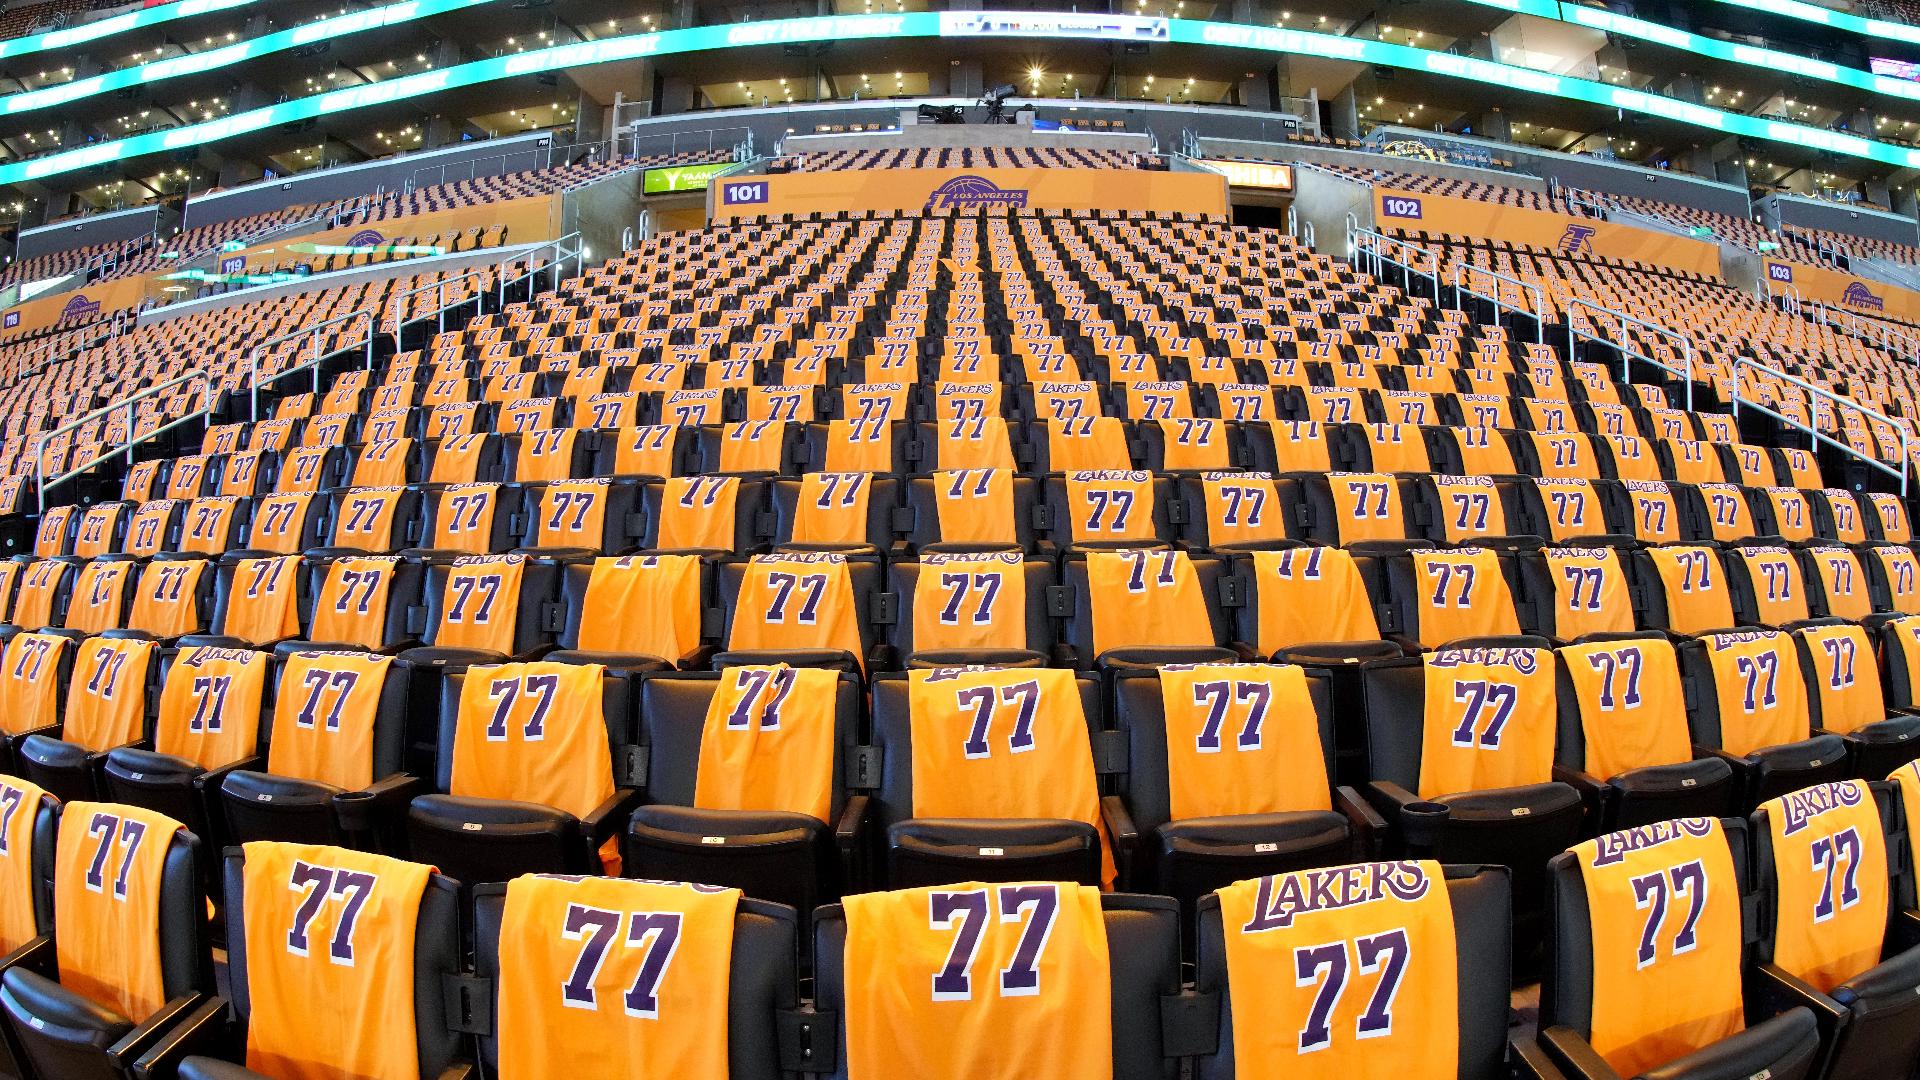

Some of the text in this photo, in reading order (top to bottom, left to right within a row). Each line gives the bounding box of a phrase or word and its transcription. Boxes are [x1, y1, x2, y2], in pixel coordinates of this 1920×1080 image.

[729, 184, 761, 202] 101
[1386, 199, 1419, 216] 102
[226, 259, 243, 273] 119
[1770, 265, 1790, 280] 103
[836, 310, 857, 323] 77
[953, 341, 981, 357] 77
[953, 354, 981, 373] 77
[1038, 354, 1066, 373] 77
[1119, 354, 1147, 371] 77
[645, 363, 675, 383] 77
[721, 359, 748, 380] 77
[1270, 359, 1295, 376] 77
[381, 384, 400, 407] 77
[850, 383, 901, 395] LAKERS
[939, 382, 993, 396] LAKERS
[1038, 381, 1092, 394] LAKERS
[1641, 386, 1662, 403] 77
[513, 411, 541, 433] 77
[592, 402, 622, 429] 77
[675, 404, 706, 427] 77
[768, 394, 801, 421] 77
[859, 396, 892, 420] 77
[950, 399, 984, 420] 77
[1050, 398, 1083, 419] 77
[1143, 395, 1174, 420] 77
[1232, 396, 1262, 421] 77
[1323, 397, 1351, 423] 77
[1400, 401, 1425, 425] 77
[1474, 407, 1498, 429] 77
[1603, 412, 1623, 435] 77
[532, 429, 565, 456] 77
[633, 425, 672, 452] 77
[849, 418, 888, 443] 77
[1177, 418, 1214, 446] 77
[1712, 423, 1728, 442] 77
[1550, 438, 1577, 468] 77
[1740, 449, 1761, 474] 77
[1789, 450, 1806, 471] 77
[131, 467, 152, 492] 77
[176, 464, 201, 490] 77
[231, 456, 256, 484] 77
[294, 454, 321, 485] 77
[1437, 474, 1494, 487] LAKERS
[816, 473, 867, 510] 77
[1221, 487, 1266, 527] 77
[1349, 483, 1389, 519] 77
[192, 507, 223, 540] 77
[262, 501, 298, 536] 77
[345, 498, 385, 534] 77
[449, 492, 489, 534] 77
[548, 492, 595, 532] 77
[1086, 490, 1135, 532] 77
[1452, 493, 1490, 531] 77
[1551, 492, 1584, 526] 77
[1639, 498, 1666, 534] 77
[1712, 494, 1738, 527] 77
[1780, 499, 1802, 528] 77
[1834, 503, 1853, 532] 77
[1881, 505, 1898, 532] 77
[43, 515, 64, 543] 77
[84, 515, 106, 543] 77
[135, 517, 159, 550] 77
[28, 561, 60, 589] 77
[153, 566, 190, 603] 77
[247, 556, 289, 599] 77
[1120, 550, 1176, 594] 77
[1427, 562, 1475, 608] 77
[1676, 551, 1712, 593] 77
[1760, 562, 1791, 602] 77
[1829, 560, 1852, 596] 77
[1893, 560, 1914, 596] 77
[335, 570, 382, 615] 77
[447, 575, 502, 624] 77
[765, 572, 828, 625] 77
[940, 572, 1002, 625] 77
[1564, 566, 1603, 612] 77
[13, 637, 51, 683] 77
[86, 646, 127, 700] 77
[1429, 648, 1538, 675] LAKERS
[1821, 636, 1855, 690] 77
[1586, 647, 1642, 711] 77
[1736, 650, 1778, 714] 77
[190, 675, 232, 733] 77
[297, 669, 359, 732] 77
[486, 674, 558, 742] 77
[726, 668, 798, 731] 77
[1452, 679, 1517, 750] 77
[957, 677, 1040, 760] 77
[1192, 681, 1272, 752] 77
[0, 783, 23, 856] 7
[1780, 780, 1863, 837] LAKERS
[85, 812, 147, 902] 77
[1592, 816, 1713, 868] LAKERS
[1811, 825, 1863, 924] 77
[286, 859, 377, 967] 77
[1240, 860, 1430, 934] LAKERS
[1628, 858, 1708, 971] 77
[929, 883, 1059, 1001] 77
[561, 901, 684, 1020] 77
[1293, 926, 1411, 1055] 77
